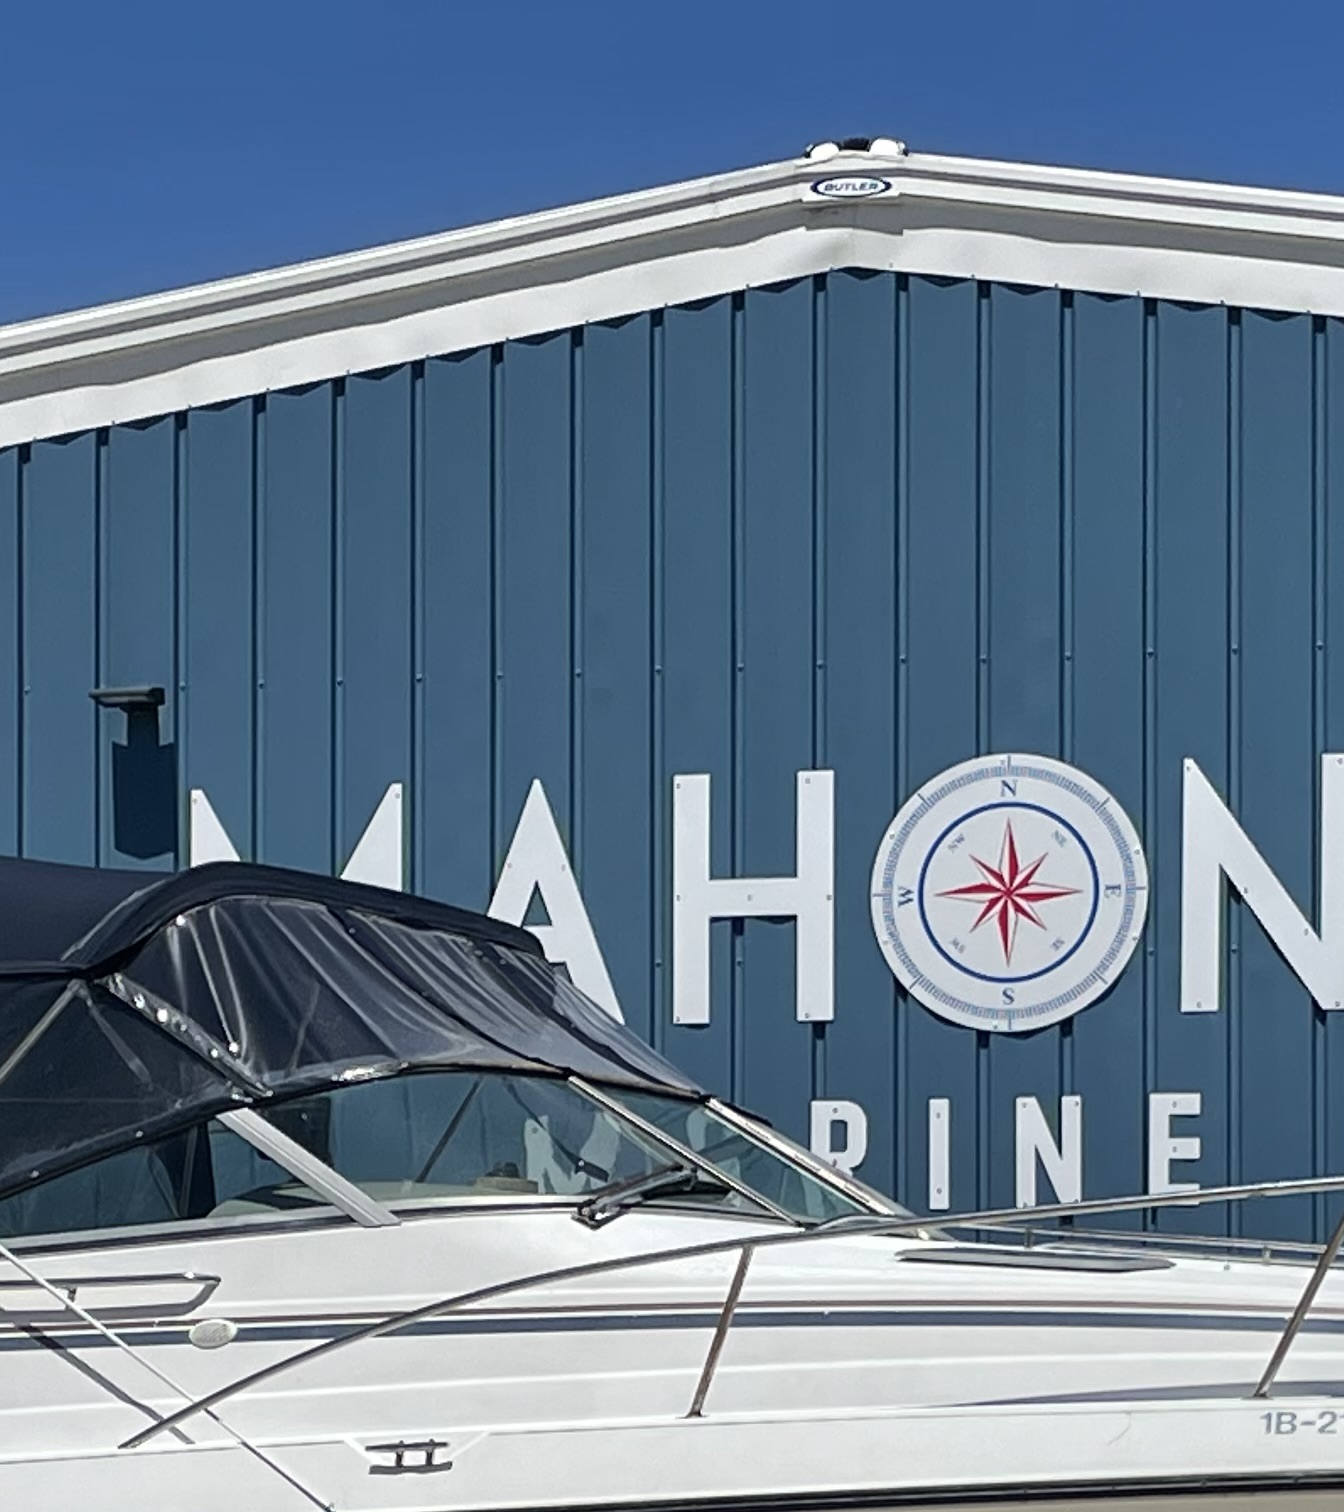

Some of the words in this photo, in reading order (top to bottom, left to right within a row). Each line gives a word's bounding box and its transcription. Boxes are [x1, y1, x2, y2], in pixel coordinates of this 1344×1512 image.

[824, 182, 878, 192] BUTLER
[1000, 779, 1019, 798] N
[897, 886, 915, 908] W
[1105, 883, 1122, 899] E
[1002, 987, 1016, 1005] S
